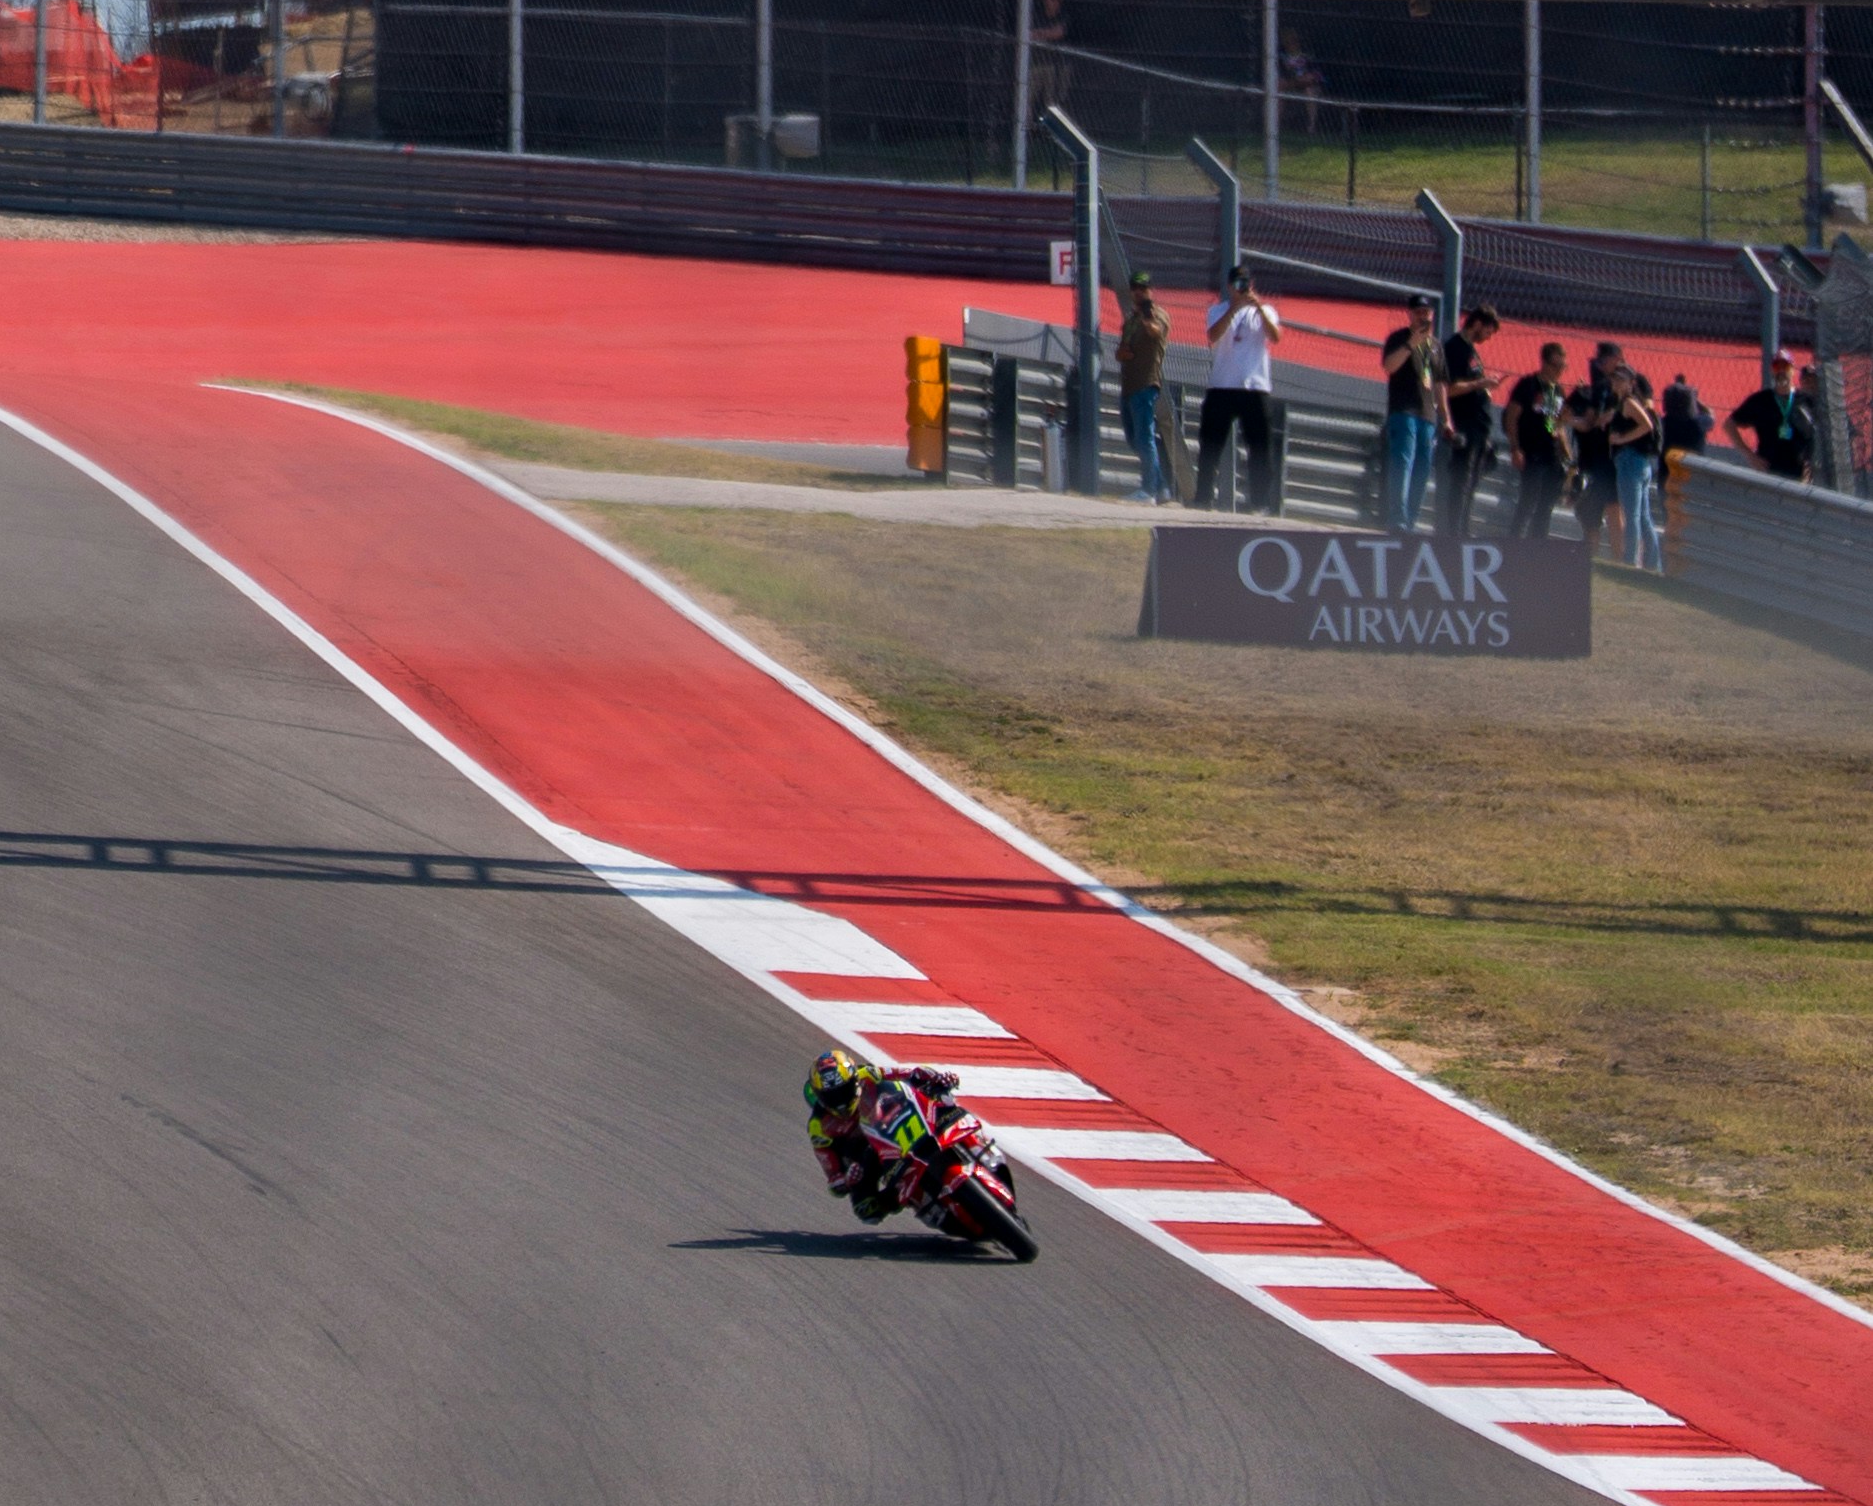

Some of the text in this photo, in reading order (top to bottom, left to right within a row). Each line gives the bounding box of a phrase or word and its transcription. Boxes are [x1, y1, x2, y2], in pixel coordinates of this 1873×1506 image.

[1237, 536, 1508, 603] QATAR
[1308, 605, 1510, 648] AIRWAYS
[895, 1114, 926, 1158] 11
